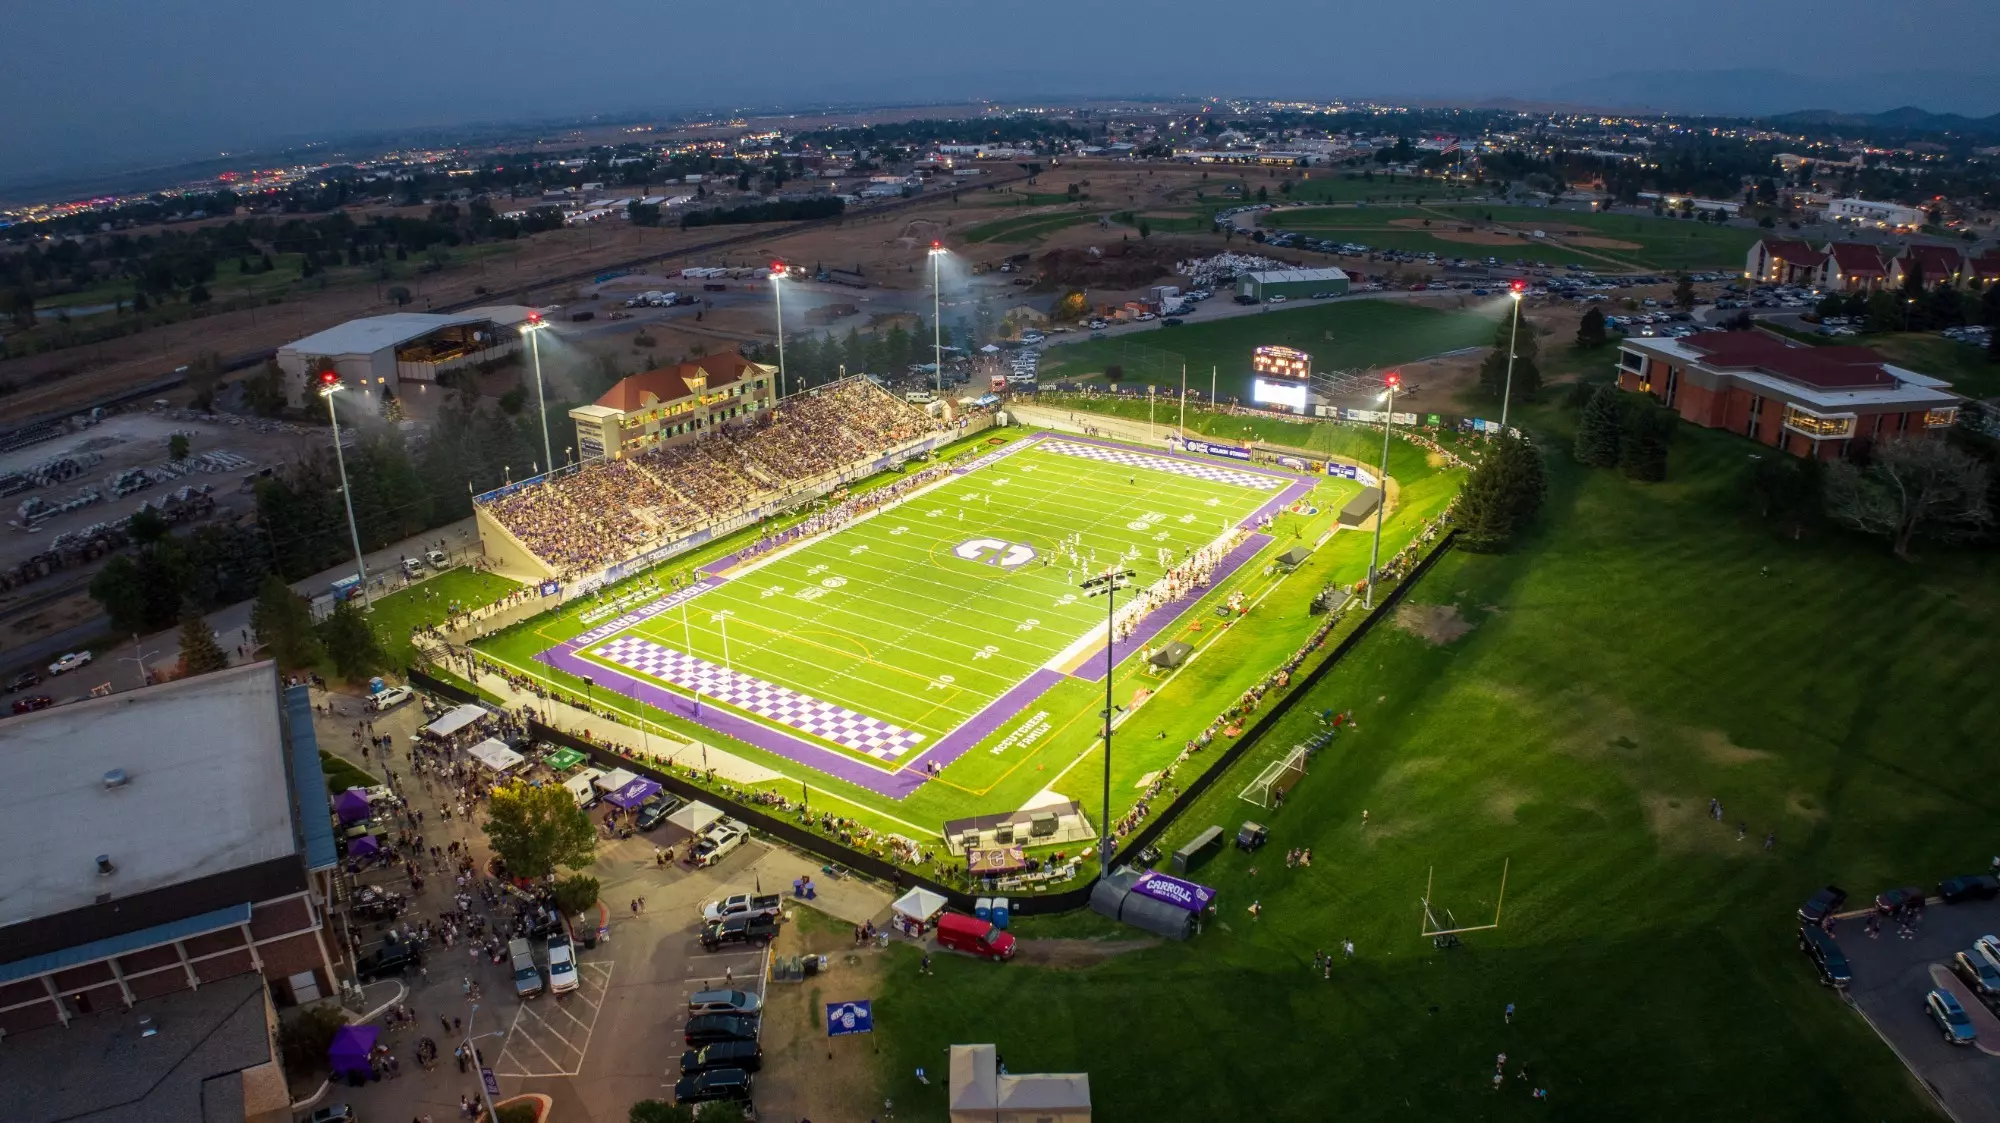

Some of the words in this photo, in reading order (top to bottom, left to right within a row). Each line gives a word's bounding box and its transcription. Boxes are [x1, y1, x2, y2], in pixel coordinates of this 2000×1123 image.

[623, 557, 644, 570] MODEL
[648, 539, 689, 560] EXCELLENCE
[639, 582, 713, 616] FIGHTING
[576, 614, 640, 644] SAINTS
[1016, 722, 1052, 749] FAMILY
[1146, 880, 1192, 902] CARROLL
